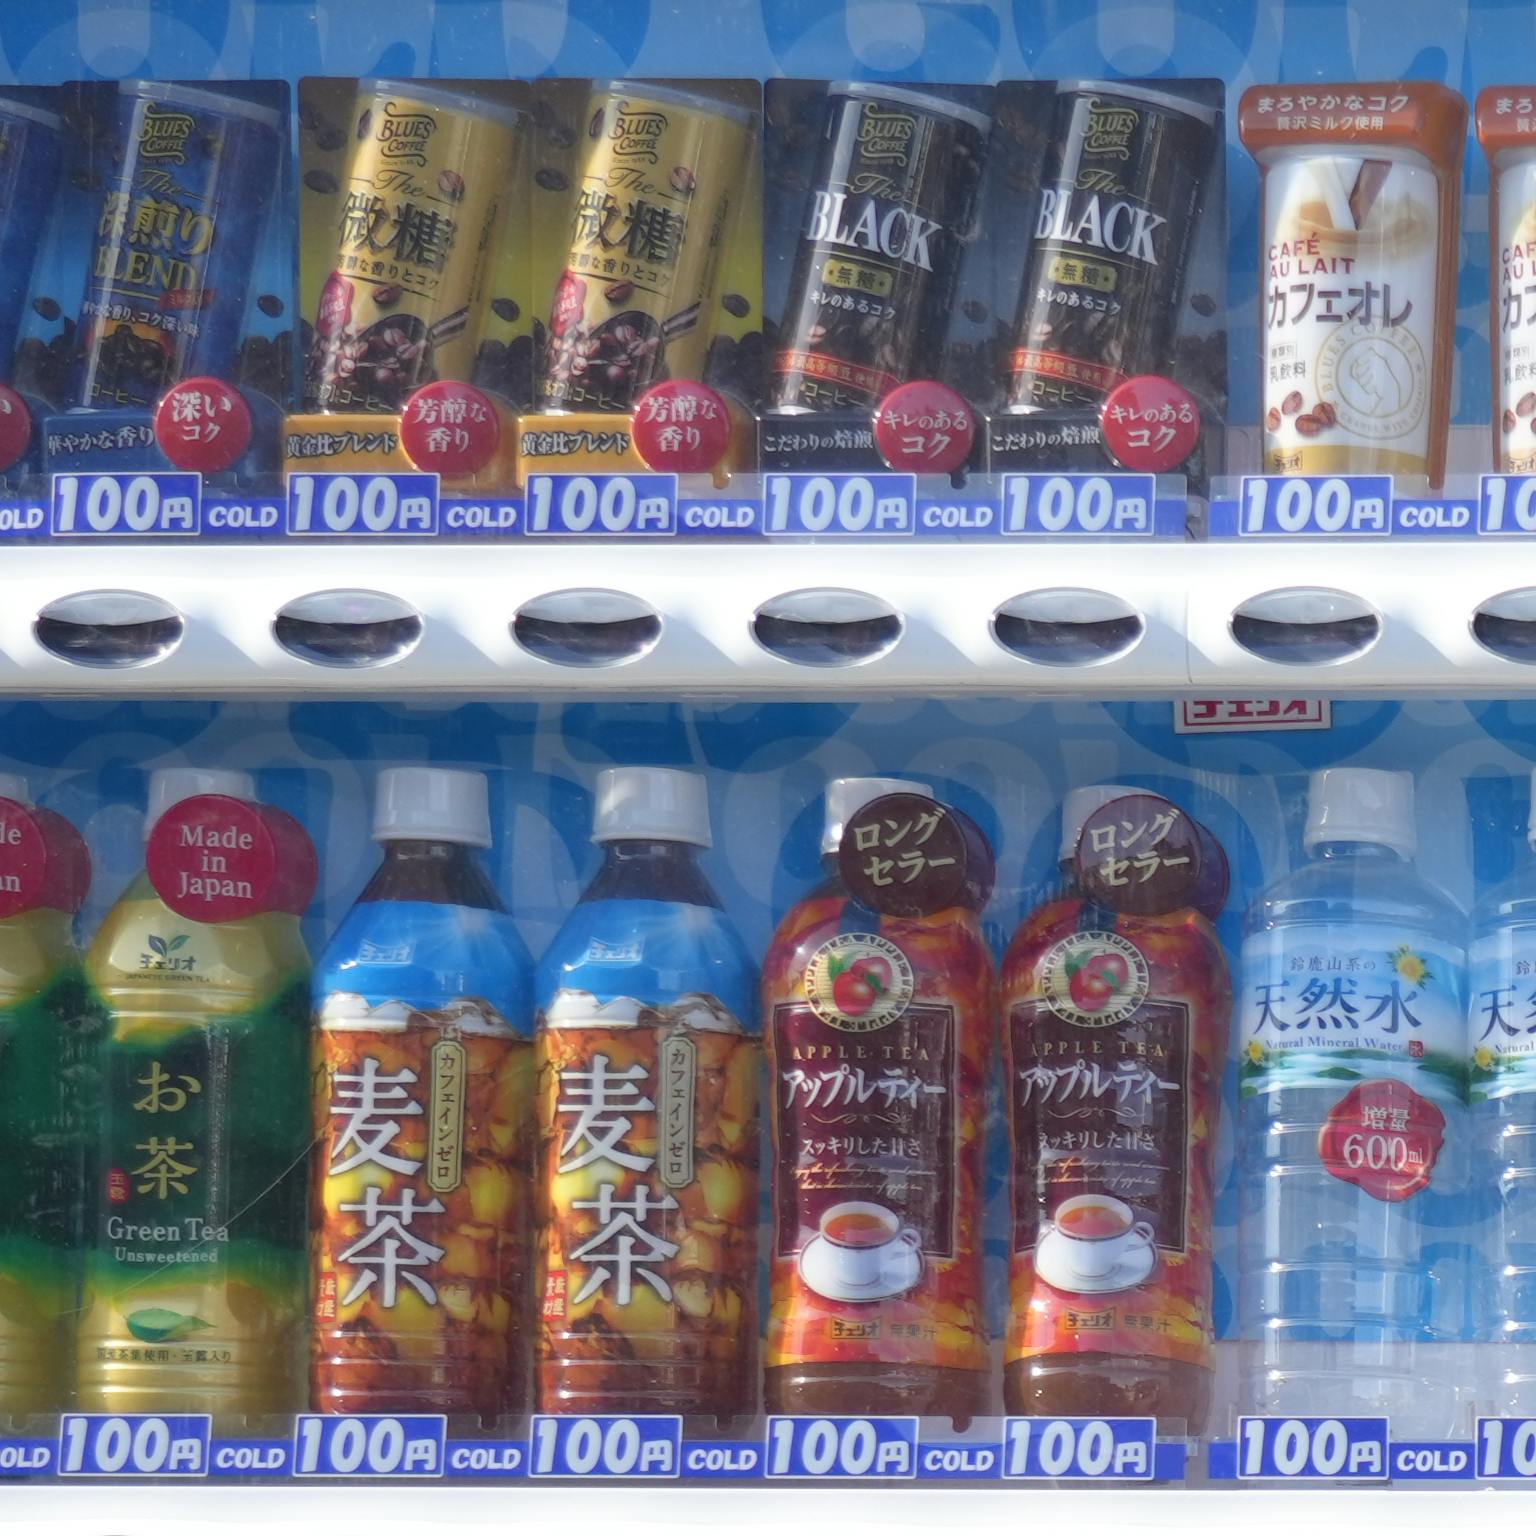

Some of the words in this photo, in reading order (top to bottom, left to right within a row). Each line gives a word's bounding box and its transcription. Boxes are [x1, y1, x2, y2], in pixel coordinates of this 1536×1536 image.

[1257, 95, 1410, 113] まろやかなコク
[1276, 116, 1384, 131] 贅沢ミルク使用
[339, 190, 457, 272] 微糖
[806, 190, 943, 272] BLACK
[1035, 188, 1166, 266] BLACK
[1268, 233, 1321, 260] CAFÉ
[1270, 260, 1291, 278] AU
[1297, 257, 1356, 276] LAIT
[1267, 281, 1413, 330] カフェオレ
[172, 390, 232, 422] 深い
[413, 398, 487, 425] 芳醇な
[182, 422, 221, 443] コク
[882, 410, 968, 431] キレのある
[287, 433, 397, 457] 黄金比ブレンド
[426, 427, 470, 453] 香り
[764, 429, 873, 454] こだわりの焙煎
[901, 434, 950, 458] コク
[59, 477, 193, 531] 100円
[209, 506, 277, 528] COLD
[534, 477, 668, 531] 100円
[923, 506, 993, 528] COLD
[1008, 476, 1147, 531] 100円
[180, 825, 253, 850] Made
[853, 808, 946, 850] ロング
[201, 850, 228, 873] in
[863, 851, 957, 888] セラー
[178, 872, 254, 901] Japan
[1252, 980, 1423, 1036] 天然水
[1264, 1038, 1304, 1053] Natural
[1307, 1036, 1359, 1051] Mineral
[1362, 1039, 1405, 1053] Water
[782, 1069, 948, 1112] アップルティー
[435, 1052, 456, 1179] カフェインゼロ
[1361, 1106, 1411, 1132] 増量
[131, 1061, 202, 1200] お茶
[328, 1056, 447, 1309] 麦茶
[556, 1054, 681, 1307] 麦茶
[107, 1215, 181, 1242] Green
[184, 1216, 230, 1242] Tea
[114, 1246, 219, 1264] Unsweetened
[66, 1418, 201, 1472] 100円
[774, 1420, 909, 1474] 100円
[452, 1448, 521, 1470] COLD
